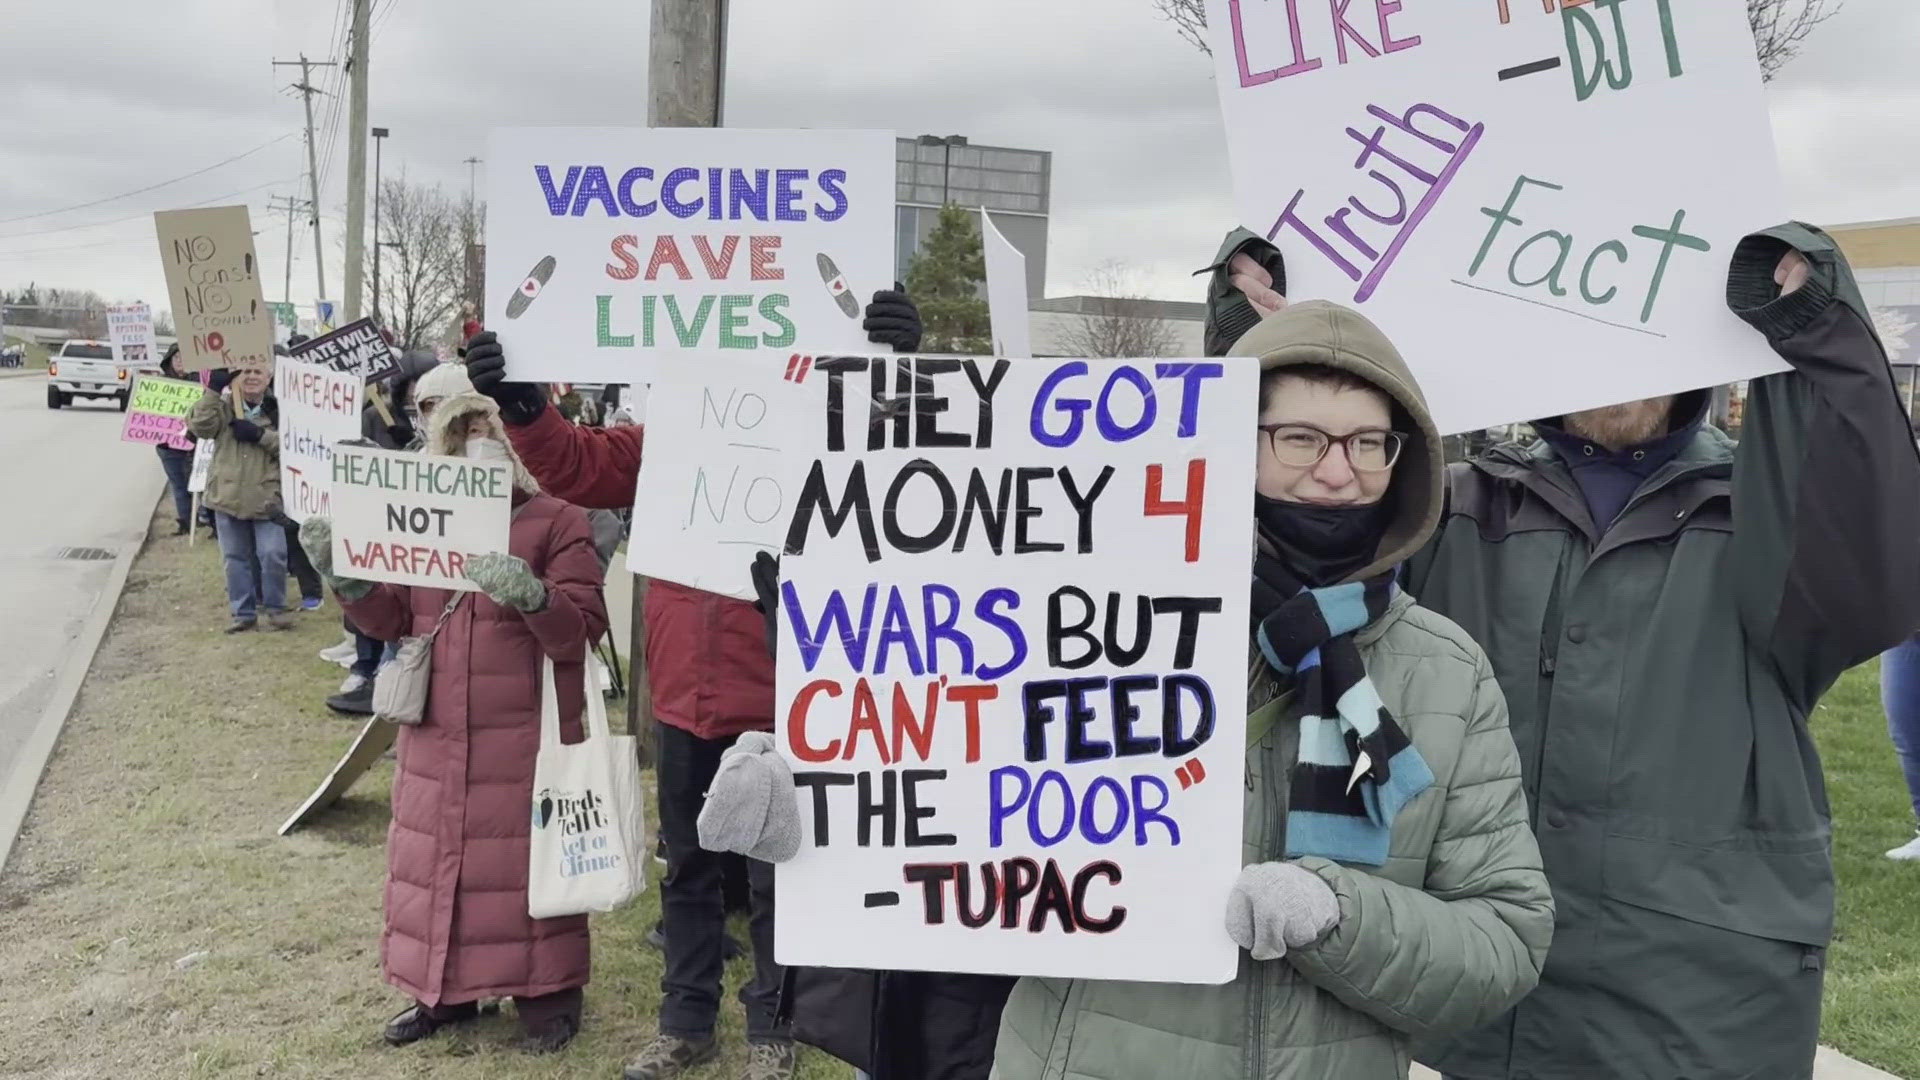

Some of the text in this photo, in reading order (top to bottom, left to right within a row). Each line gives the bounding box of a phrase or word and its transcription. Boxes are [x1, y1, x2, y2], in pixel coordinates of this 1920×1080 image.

[534, 165, 848, 221] VACCINES
[1267, 102, 1471, 282] Truth
[175, 235, 216, 264] NO
[605, 234, 785, 281] SAVE
[184, 285, 232, 315] NO
[595, 294, 797, 349] LIVES
[193, 331, 224, 356] NO
[336, 325, 379, 351] WILL
[340, 341, 388, 368] MAKE
[134, 395, 188, 416] SAFE IN
[140, 380, 158, 393] NO
[162, 384, 182, 397] ONE
[283, 365, 356, 417] IMPEACH
[700, 386, 767, 430] NO
[783, 354, 1224, 452] "THEY GOT
[131, 411, 187, 432] FASCIS
[284, 416, 332, 462] dictato
[286, 465, 332, 516] TRUM
[332, 453, 508, 499] HEALTHCARE
[689, 464, 783, 534] NO
[386, 503, 454, 537] NOT
[782, 457, 1207, 564] MONEY 4
[343, 538, 480, 580] WARFAR
[780, 579, 1223, 681] WARS BUT
[786, 674, 1217, 766] CAN'T FEED
[793, 756, 1207, 848] THE POOR"
